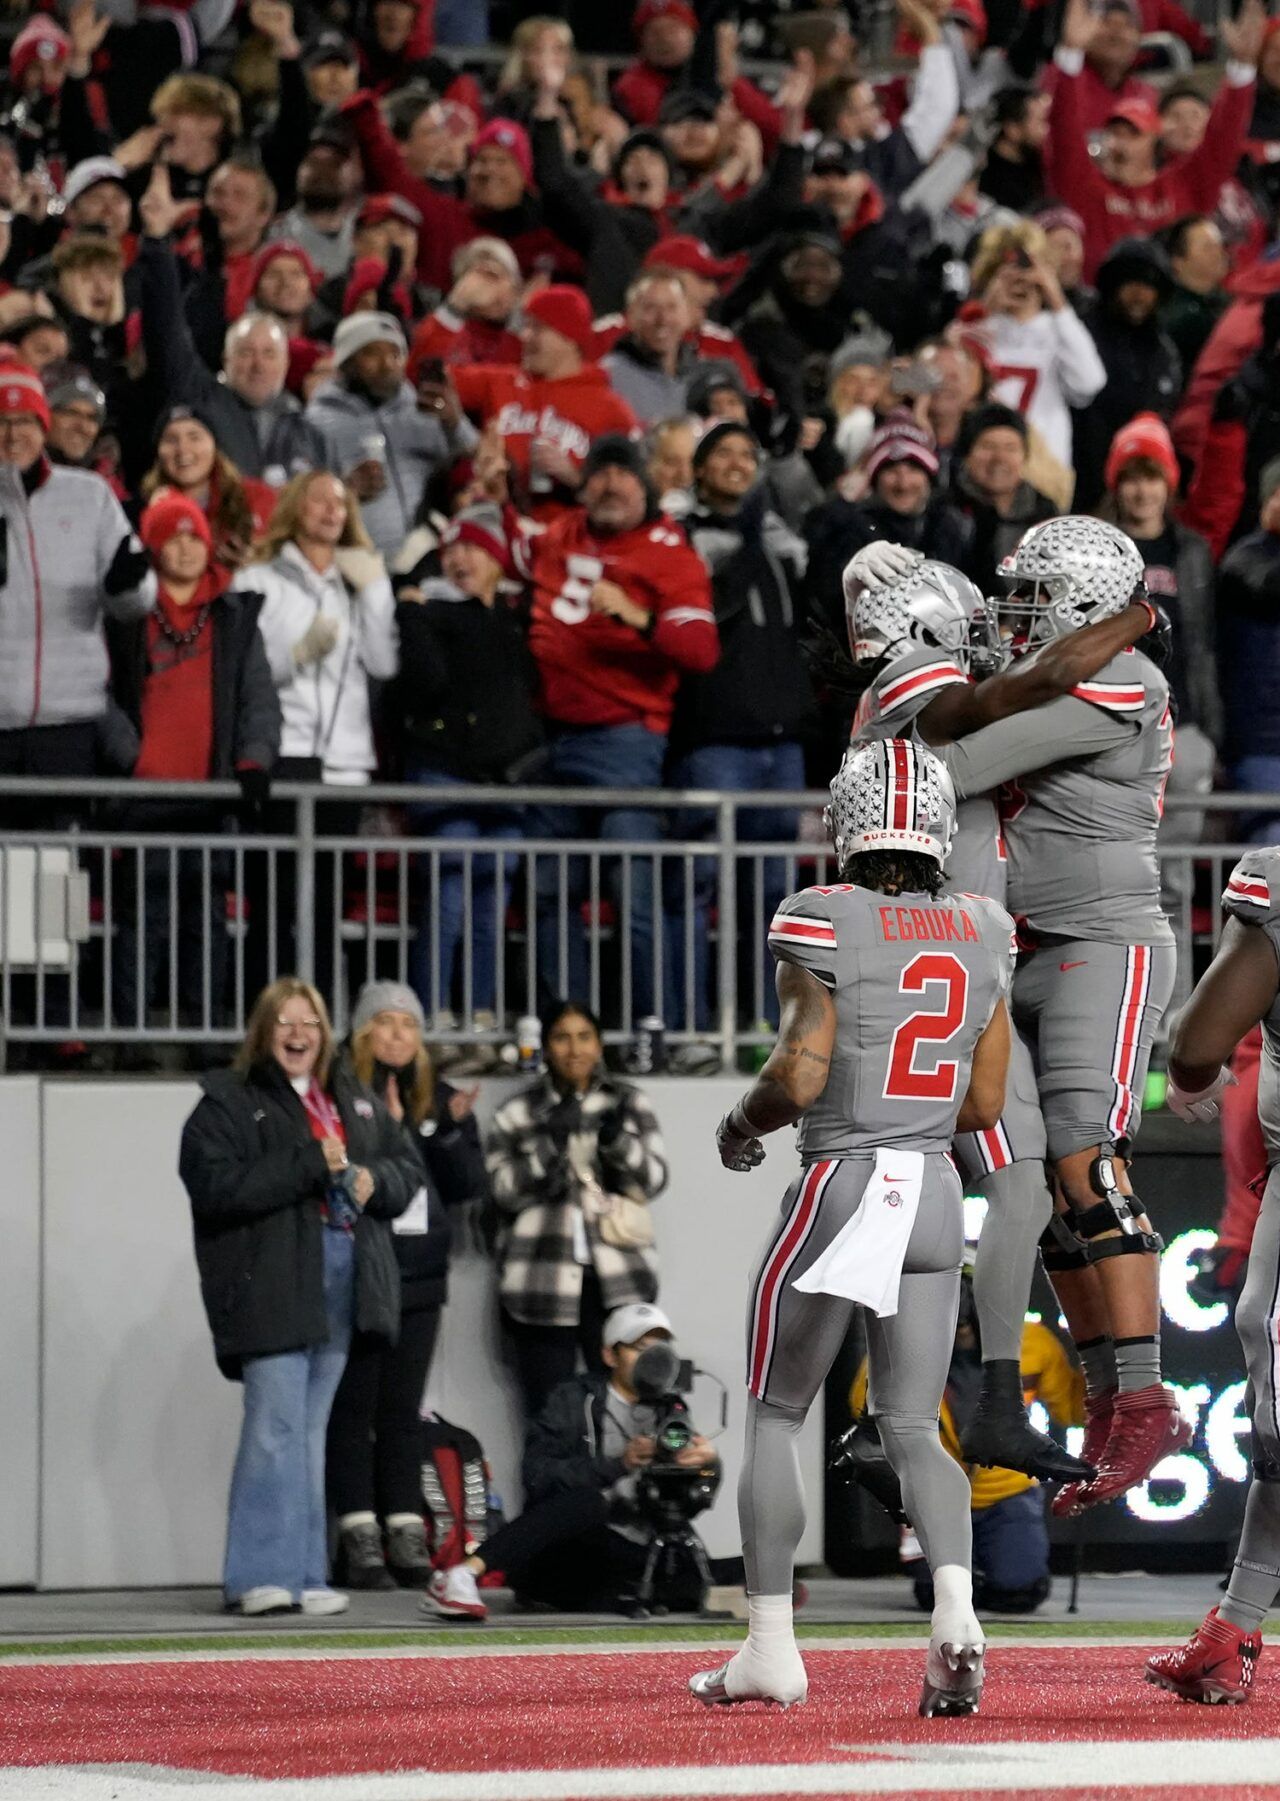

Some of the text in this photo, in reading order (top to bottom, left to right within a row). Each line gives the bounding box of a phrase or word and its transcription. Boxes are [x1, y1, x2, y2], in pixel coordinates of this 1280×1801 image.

[551, 553, 603, 625] 5
[863, 832, 931, 845] BUCKEYES
[878, 906, 980, 943] EGBUKA
[881, 951, 970, 1103] 2
